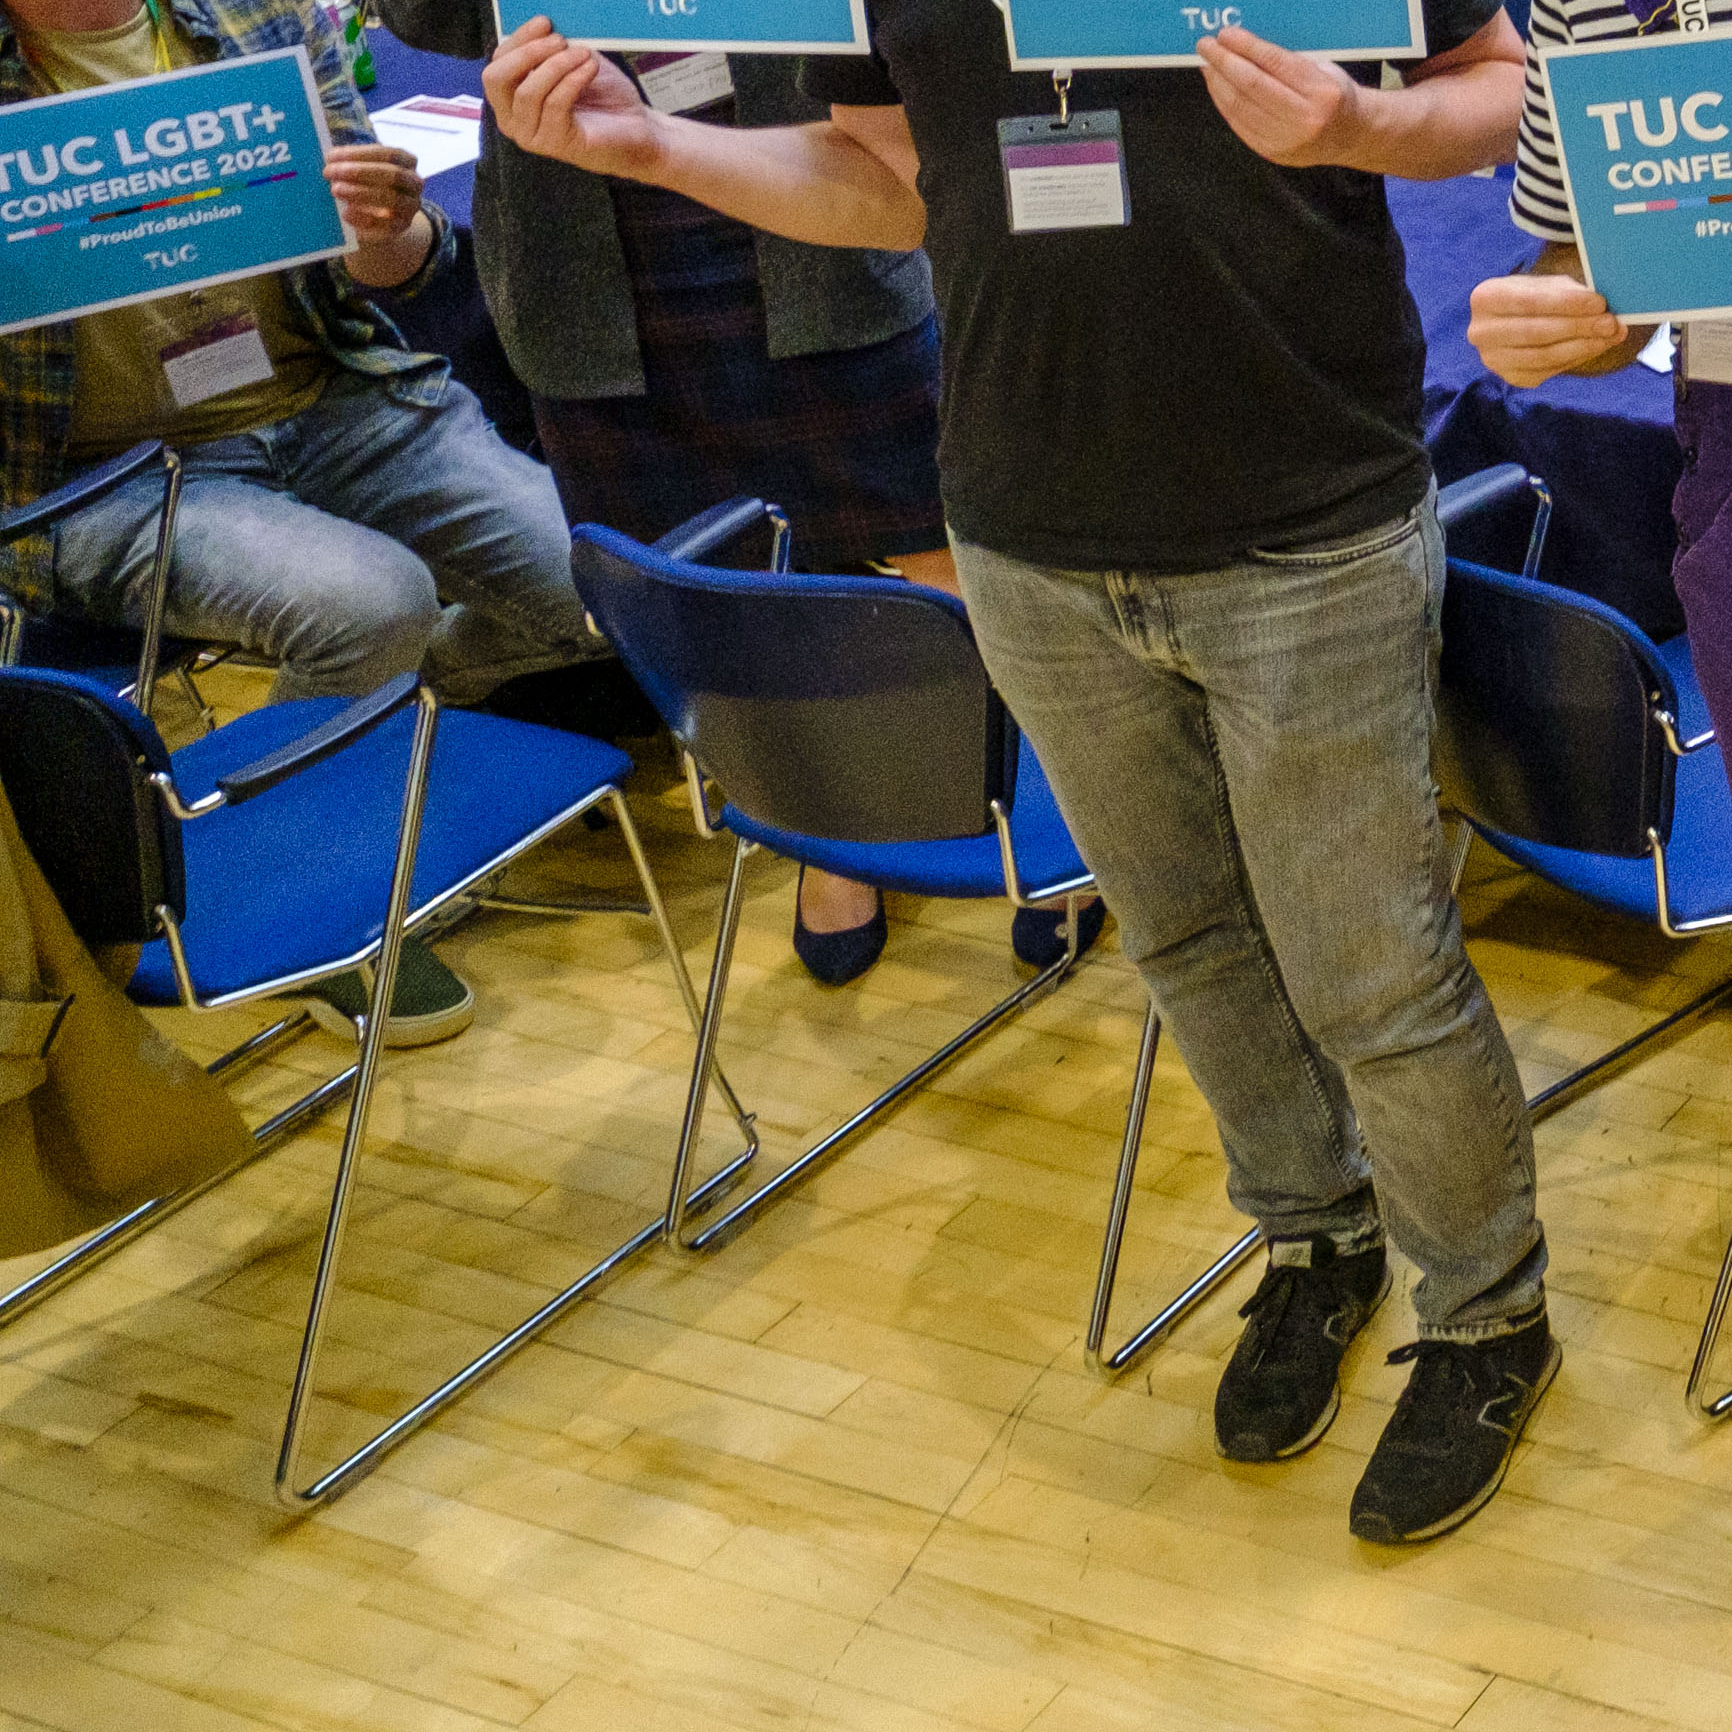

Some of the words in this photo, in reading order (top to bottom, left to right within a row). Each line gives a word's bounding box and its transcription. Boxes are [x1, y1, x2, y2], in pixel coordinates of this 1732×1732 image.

[1179, 6, 1241, 31] TUC
[113, 101, 285, 165] LGBT+
[1585, 90, 1729, 152] TUC
[0, 158, 210, 222] CONFERENCE
[215, 141, 292, 175] 2022
[78, 205, 242, 250] #ProudToBeUnion
[141, 244, 198, 272] TUC
